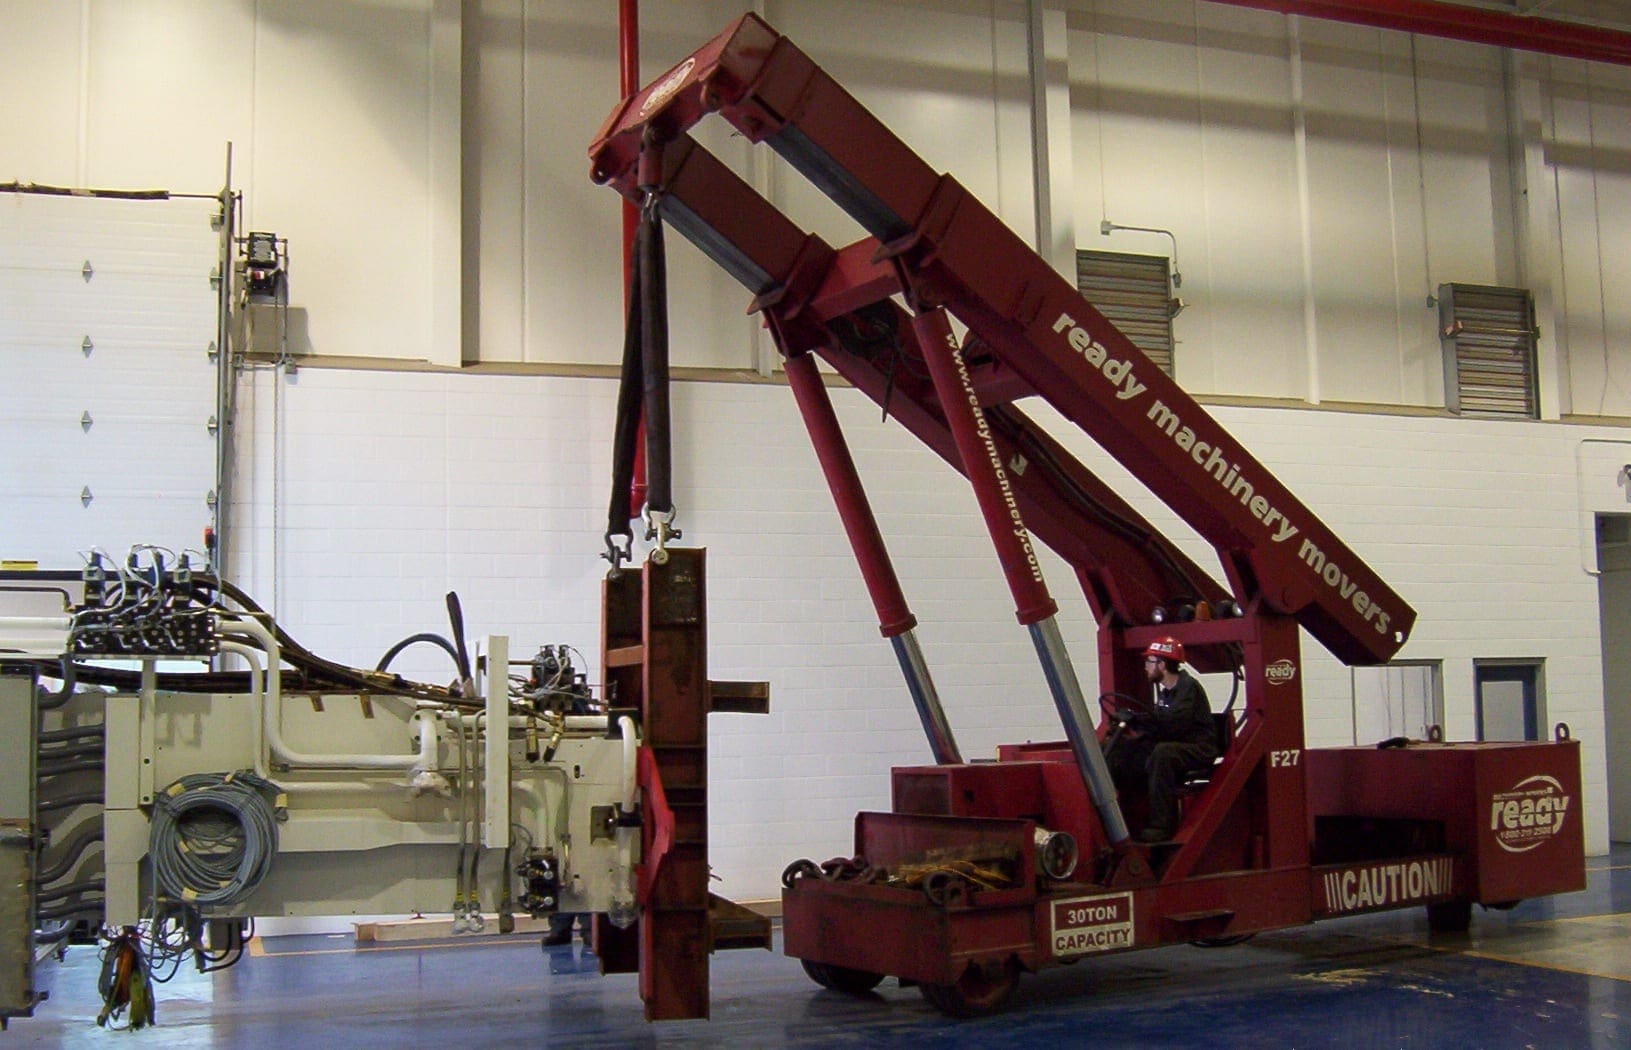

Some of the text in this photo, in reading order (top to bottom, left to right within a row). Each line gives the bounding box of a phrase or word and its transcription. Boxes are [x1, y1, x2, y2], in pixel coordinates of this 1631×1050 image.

[945, 332, 1043, 583] www.readymachinery.com
[1052, 312, 1391, 635] ready machinery movers
[1265, 664, 1296, 680] ready
[1270, 749, 1300, 767] F27
[1491, 786, 1570, 834] ready
[1342, 859, 1438, 910] CAUTION
[1055, 928, 1131, 951] CAPACITY
